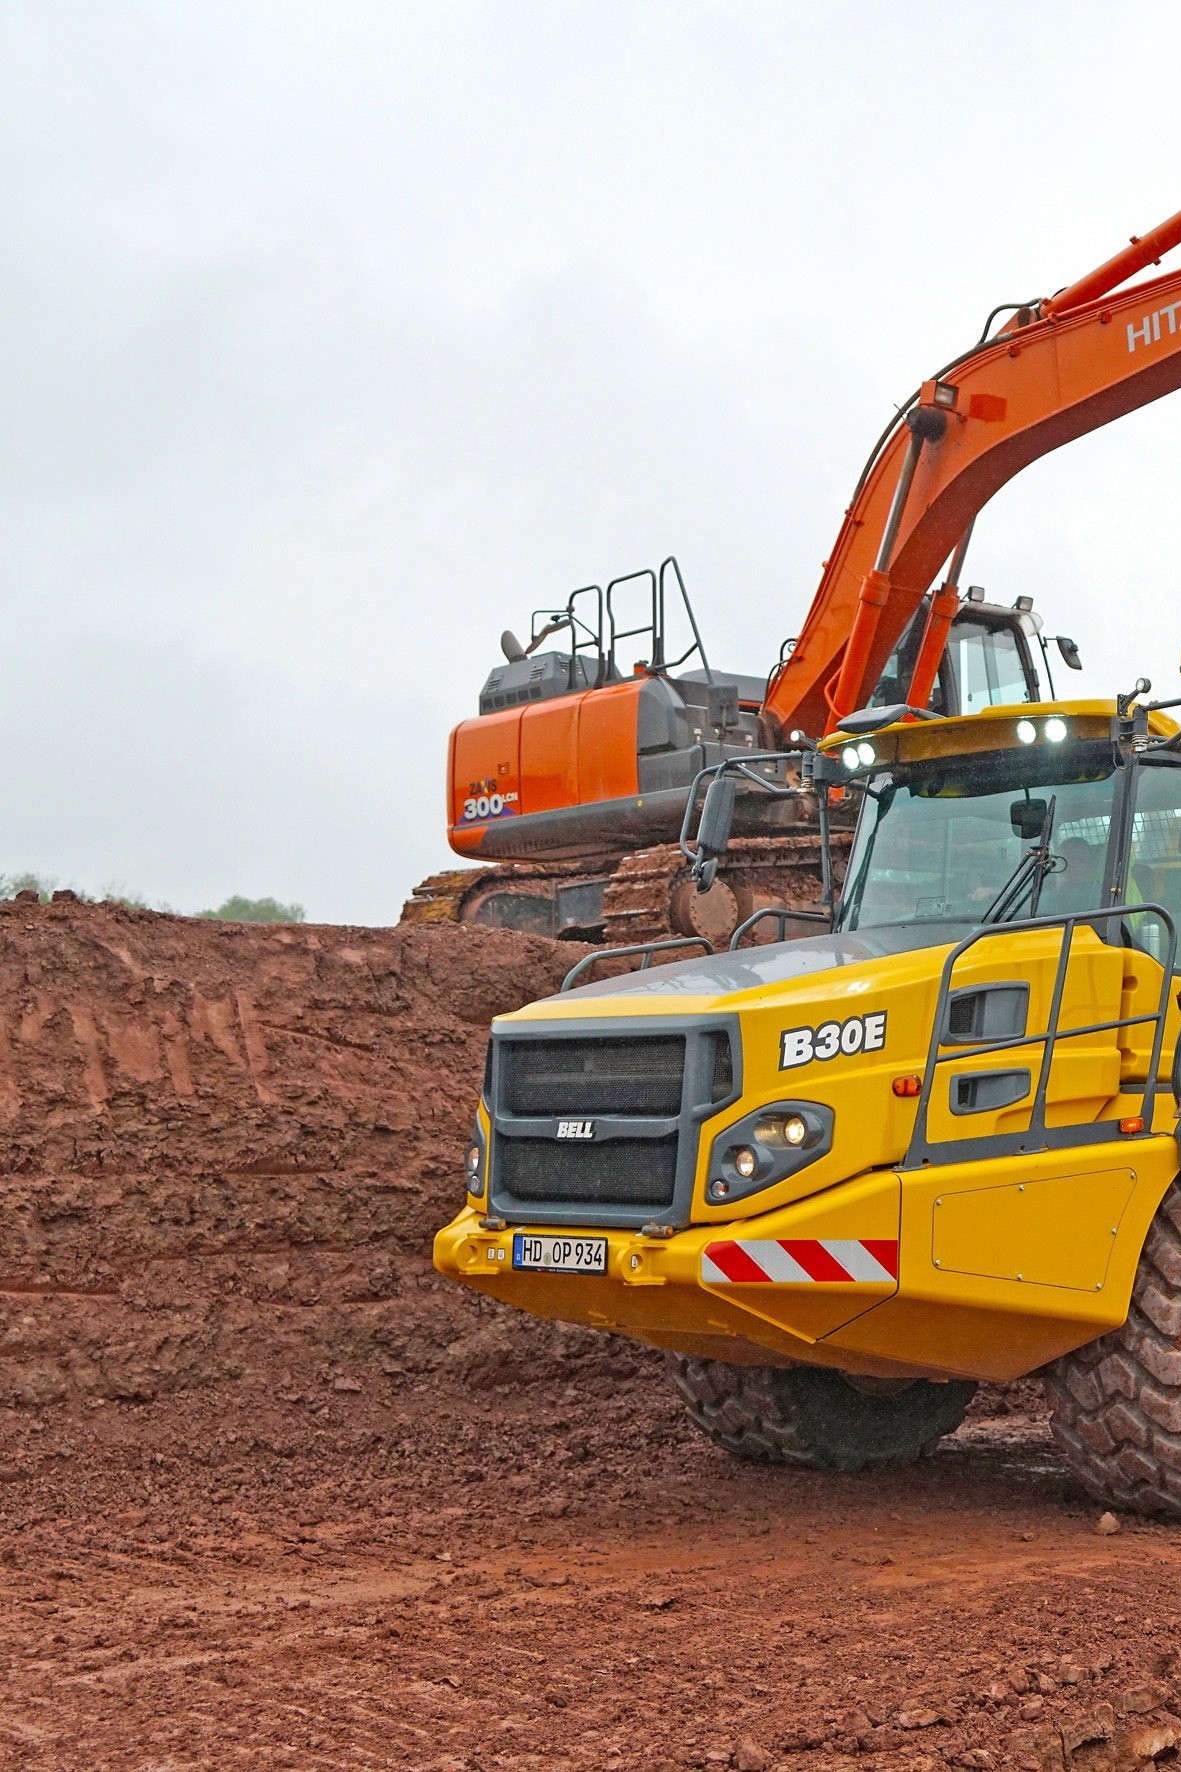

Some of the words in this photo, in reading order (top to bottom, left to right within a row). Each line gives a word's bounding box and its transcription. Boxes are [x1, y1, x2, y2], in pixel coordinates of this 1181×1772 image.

[469, 777, 497, 795] ZAXIS
[464, 793, 503, 821] 300
[779, 1010, 887, 1071] B30E
[557, 1121, 595, 1138] BELL
[523, 1239, 542, 1262] HD
[552, 1241, 572, 1264] OP
[575, 1243, 603, 1266] 934
